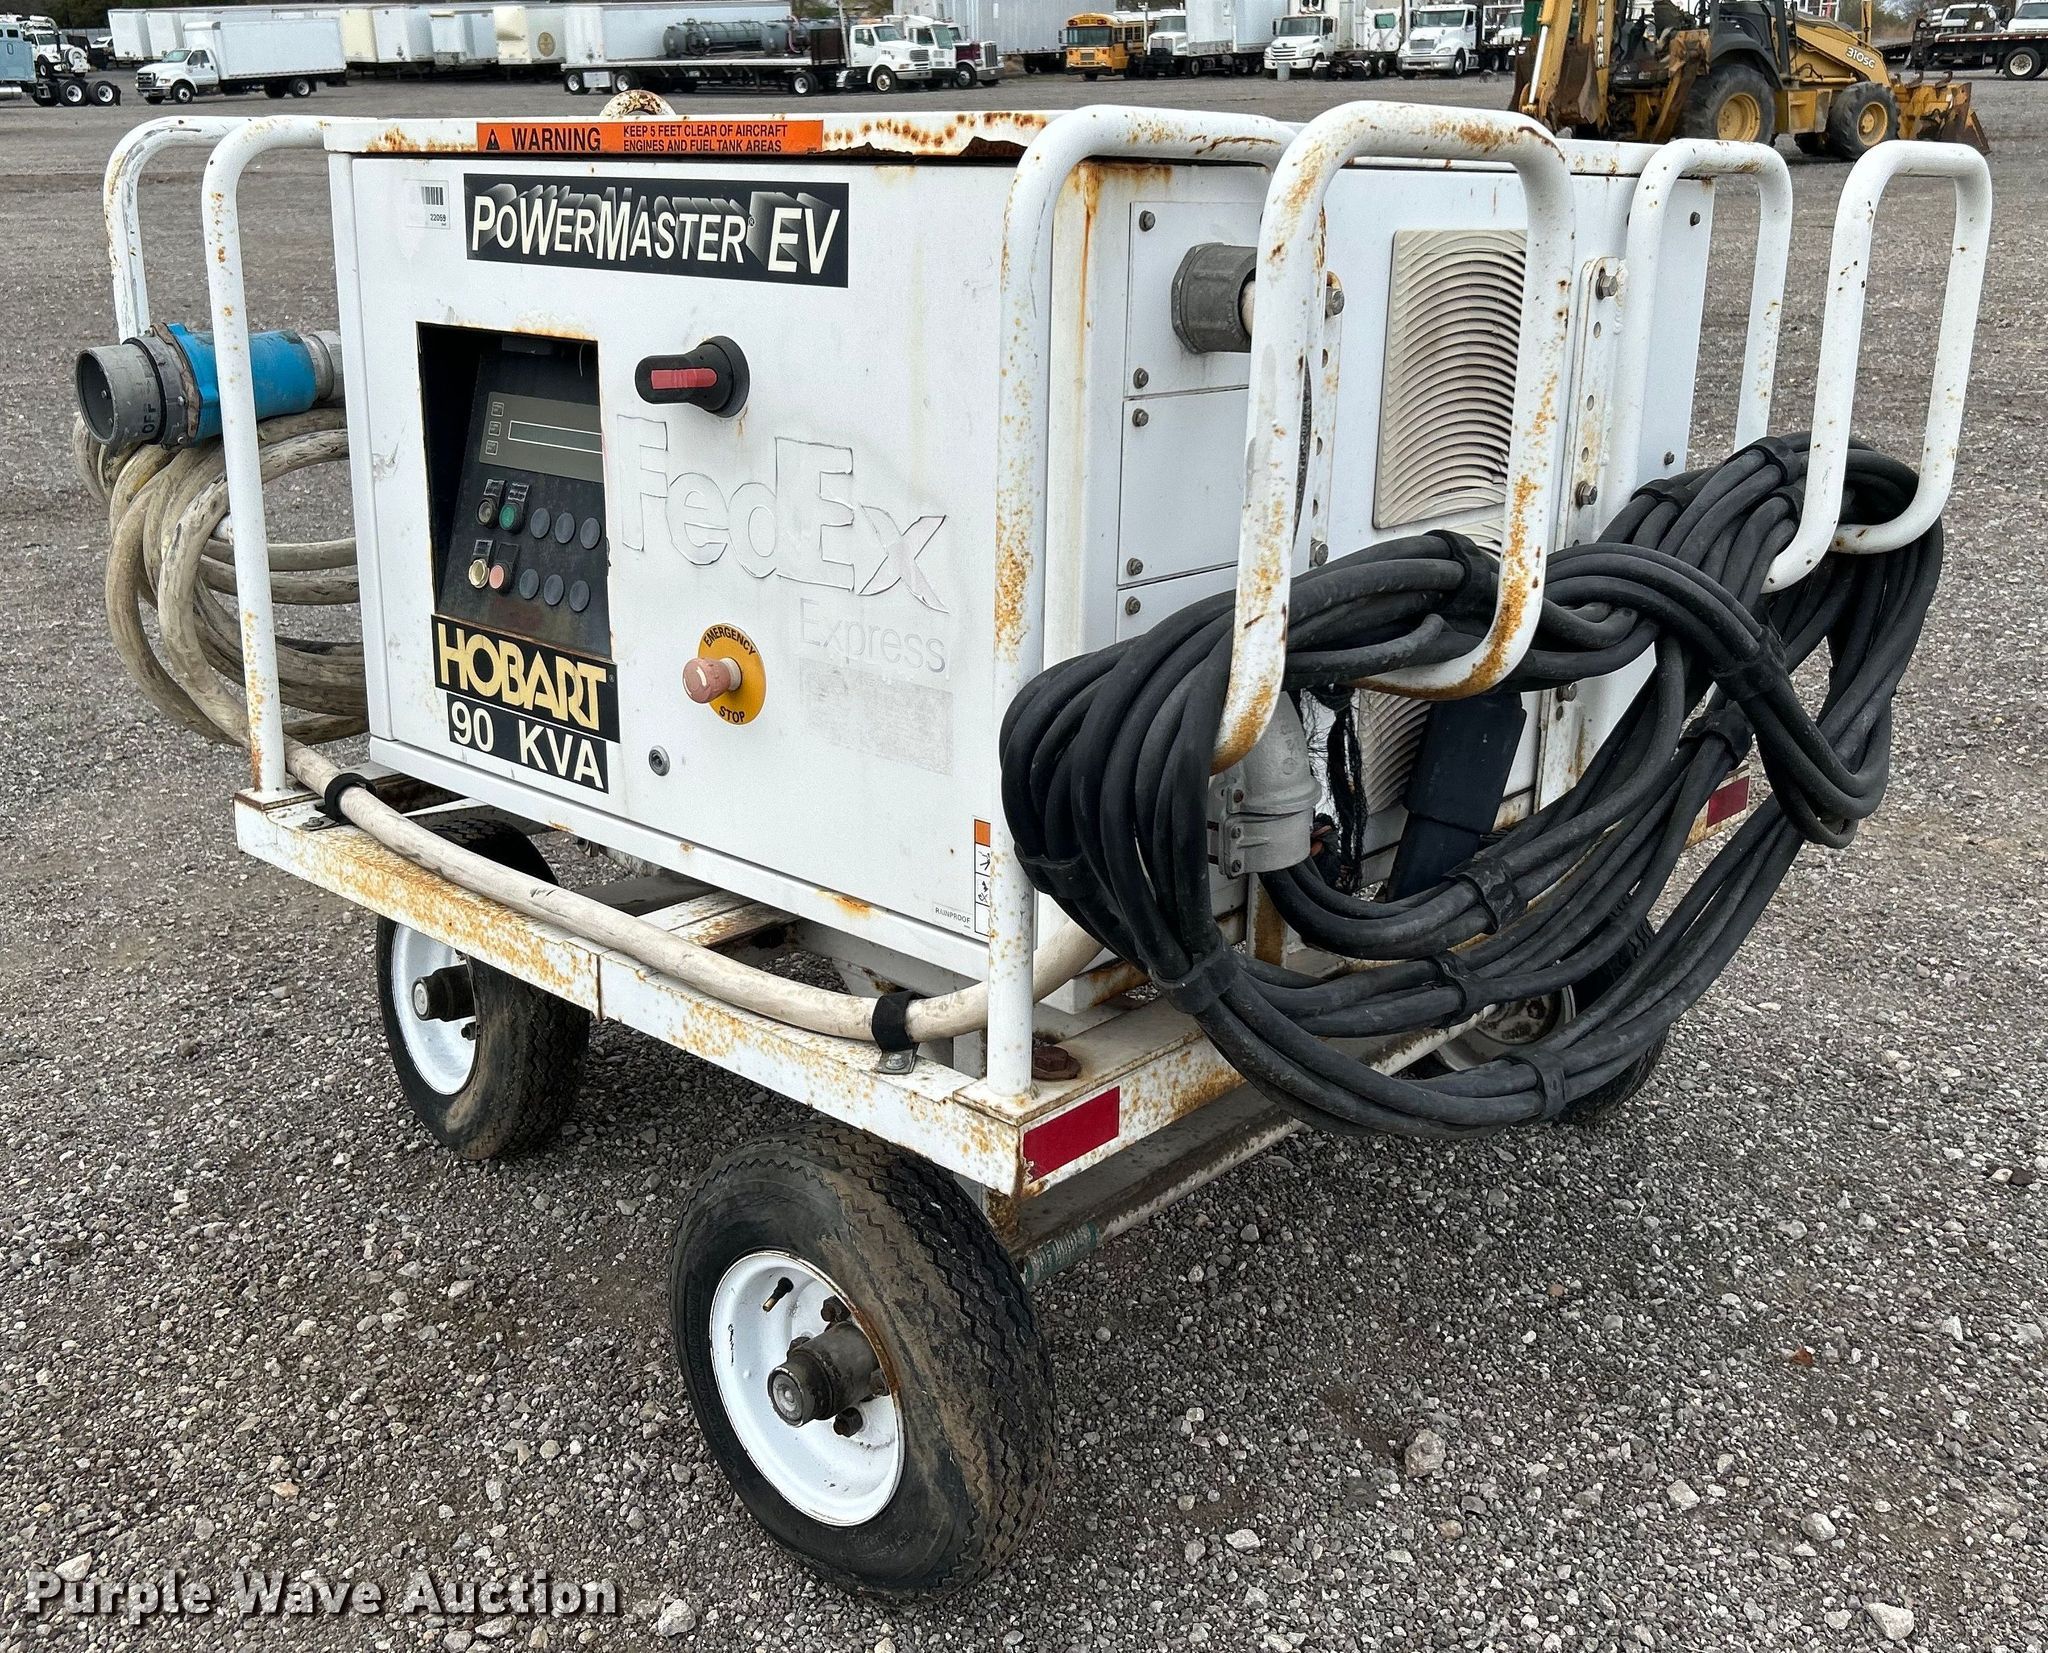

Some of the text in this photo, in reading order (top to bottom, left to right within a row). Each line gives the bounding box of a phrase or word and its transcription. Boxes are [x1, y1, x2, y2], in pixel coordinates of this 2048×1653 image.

[1845, 46, 1876, 69] 310SG
[511, 127, 601, 151] WARNING
[623, 124, 788, 138] KEEP 5 FEET CLEAR OF AIRCRAFT
[623, 139, 782, 152] ENGINES AND FUEL TANK AREAS
[767, 206, 841, 275] EV
[616, 414, 950, 614] FedEx
[703, 626, 756, 656] EMERGENCY
[799, 597, 947, 673] Express
[437, 622, 607, 731] HOBART
[719, 705, 745, 723] STOP
[451, 700, 604, 789] 90 KVA
[935, 906, 971, 924] RAINPROOF
